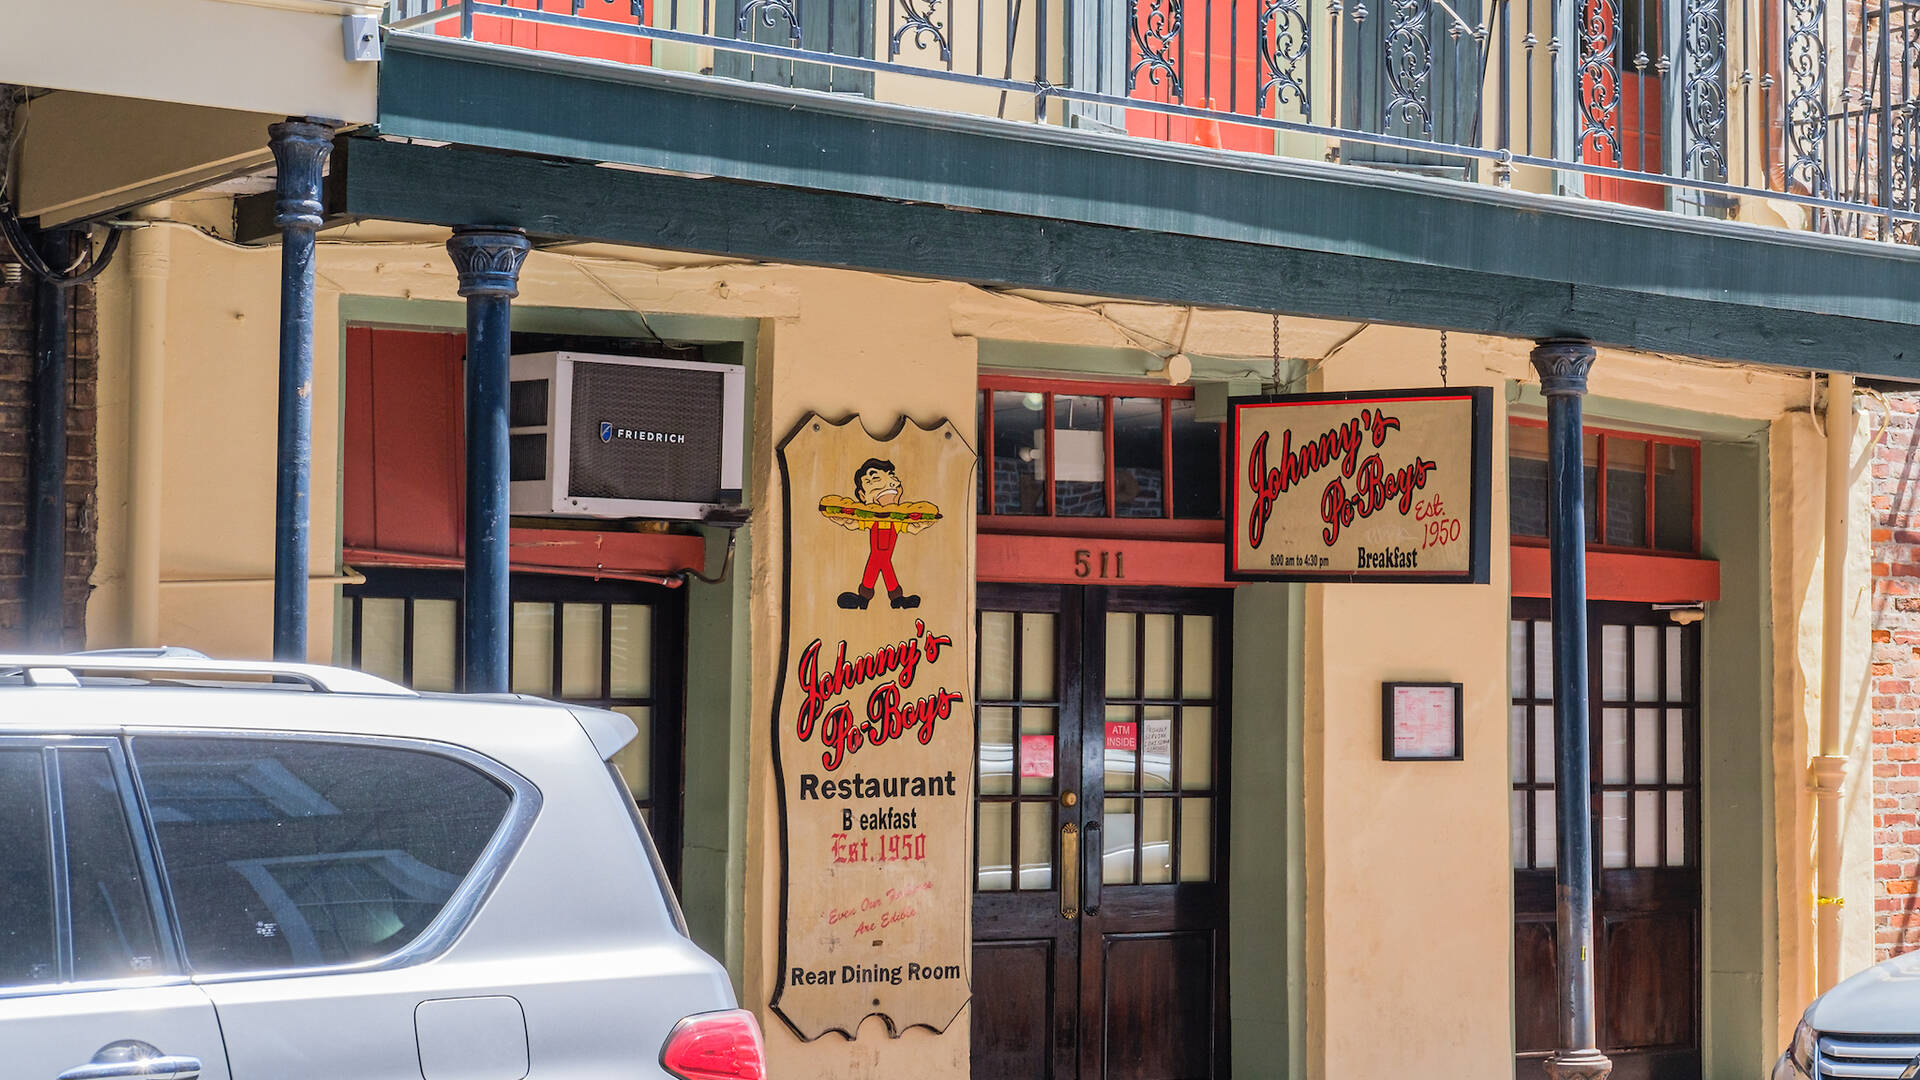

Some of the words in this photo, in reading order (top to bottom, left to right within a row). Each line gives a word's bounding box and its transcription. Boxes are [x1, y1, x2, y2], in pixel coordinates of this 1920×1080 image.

[617, 429, 685, 443] FRIEDRICH
[1249, 408, 1400, 549] Johnny's
[1321, 453, 1437, 546] Po-Boys
[1415, 493, 1446, 521] Est.
[1422, 518, 1461, 550] 1950
[1074, 550, 1125, 578] 511
[1285, 557, 1295, 566] am
[1296, 554, 1303, 566] to
[1319, 557, 1329, 569] pm
[1357, 546, 1418, 568] Breakfast
[797, 618, 952, 741] Johnny's
[821, 680, 963, 771] Po-Boys
[1112, 725, 1130, 735] ATM
[1105, 737, 1135, 747] INSIDE
[800, 771, 956, 800] Restaurant
[843, 807, 917, 831] Beakfast
[853, 921, 876, 938] Are
[791, 967, 836, 986] Rear
[841, 964, 902, 985] Dining
[908, 962, 960, 981] Room
